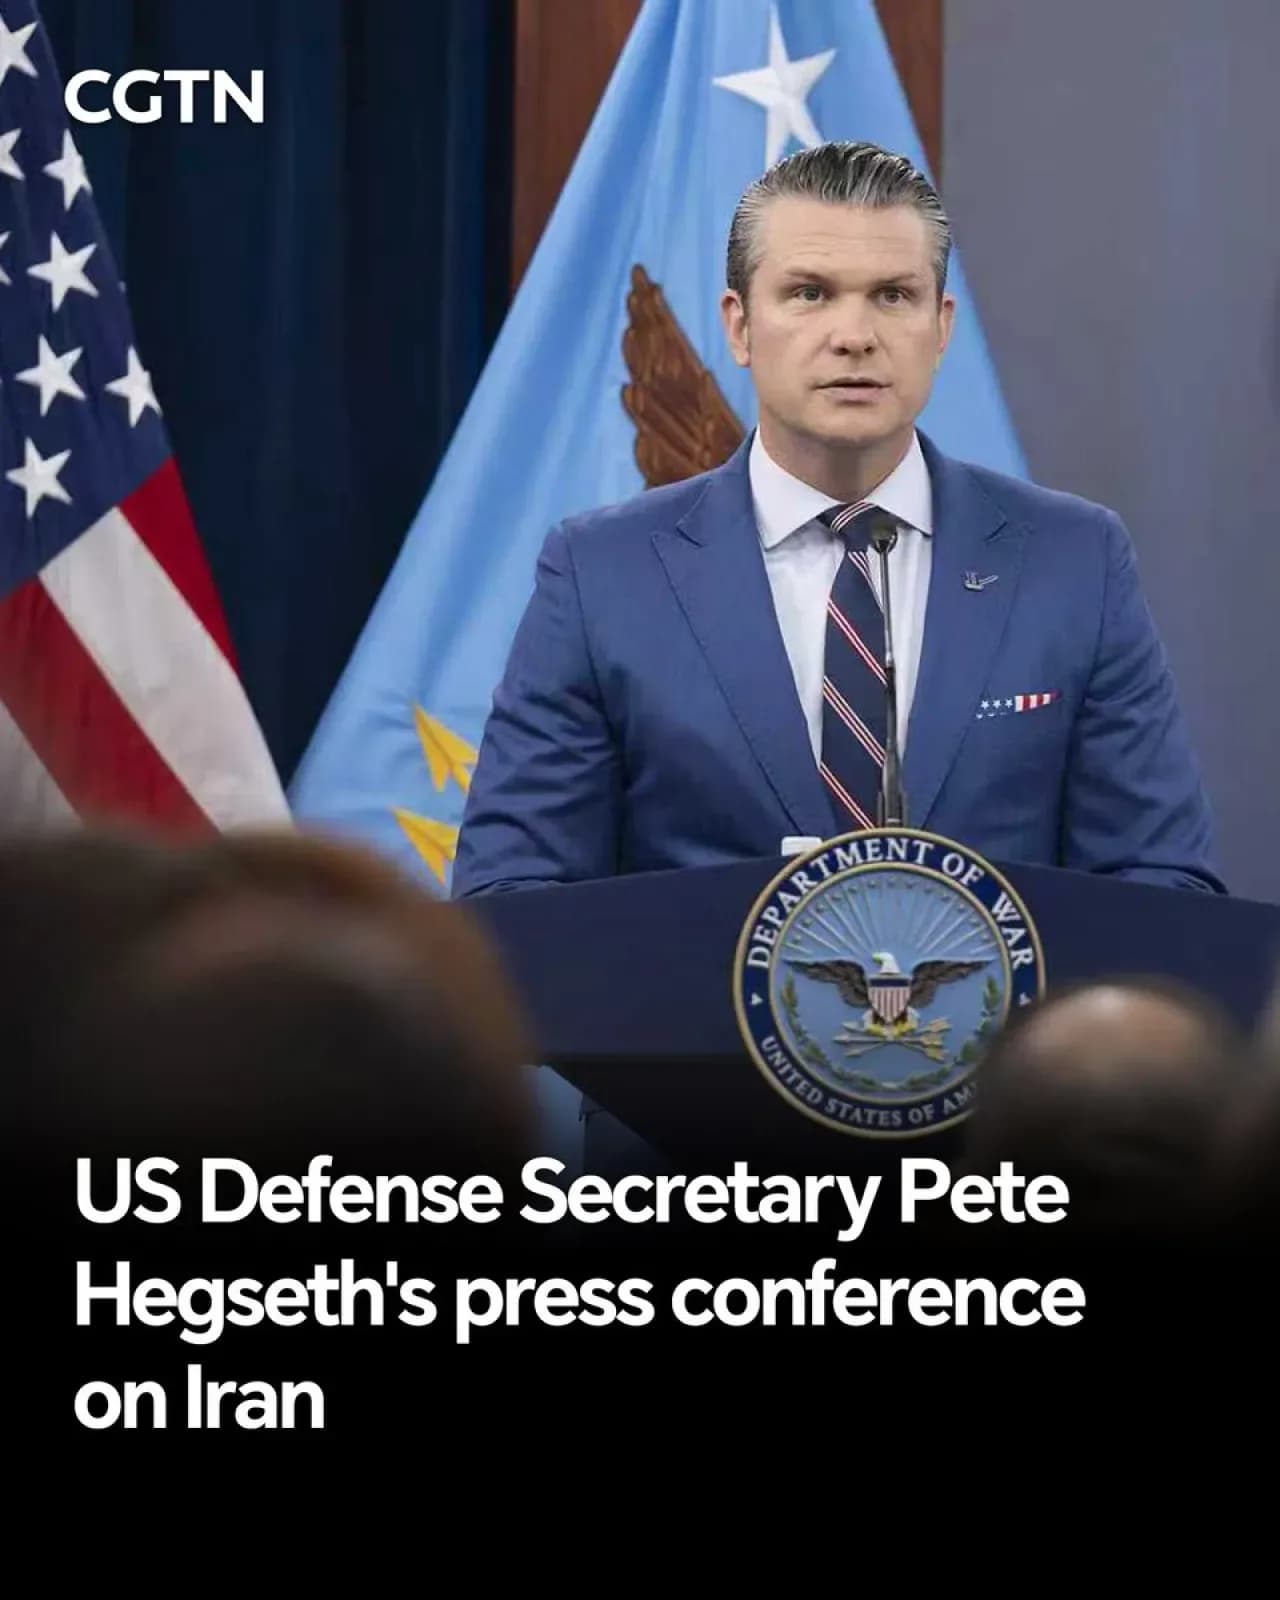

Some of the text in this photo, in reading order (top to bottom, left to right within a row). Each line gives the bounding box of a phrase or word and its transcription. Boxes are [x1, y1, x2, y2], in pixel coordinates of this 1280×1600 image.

[747, 837, 1034, 969] DEPARTMENT OF WAR
[760, 1035, 935, 1127] UNITED STATES OF
